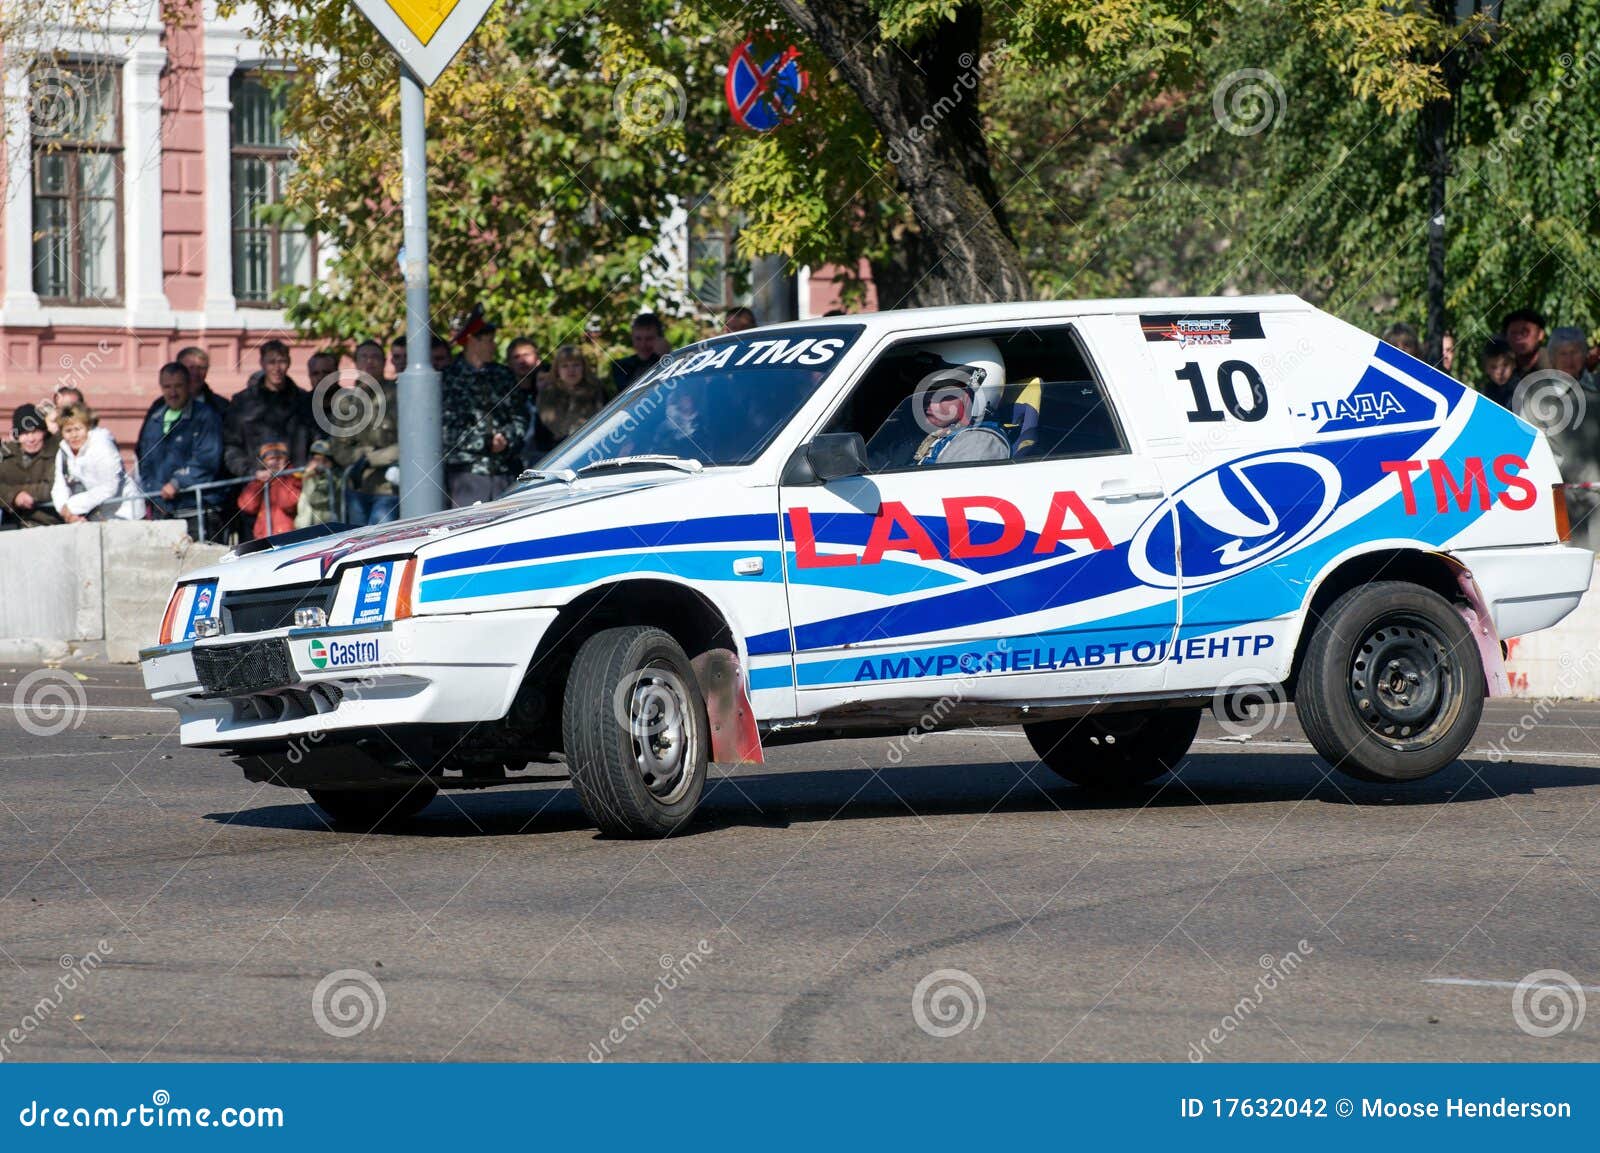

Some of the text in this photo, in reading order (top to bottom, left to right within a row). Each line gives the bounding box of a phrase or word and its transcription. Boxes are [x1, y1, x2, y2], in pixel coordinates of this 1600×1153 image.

[626, 338, 845, 394] LADA TMS
[1175, 360, 1268, 422] 10
[1288, 391, 1406, 421] -ЛАДА
[1380, 454, 1537, 516] TMS
[788, 491, 1115, 569] LADA
[330, 639, 379, 666] Castrol
[854, 634, 1275, 682] АМУРСПЕЦАВТОЦЕНТР
